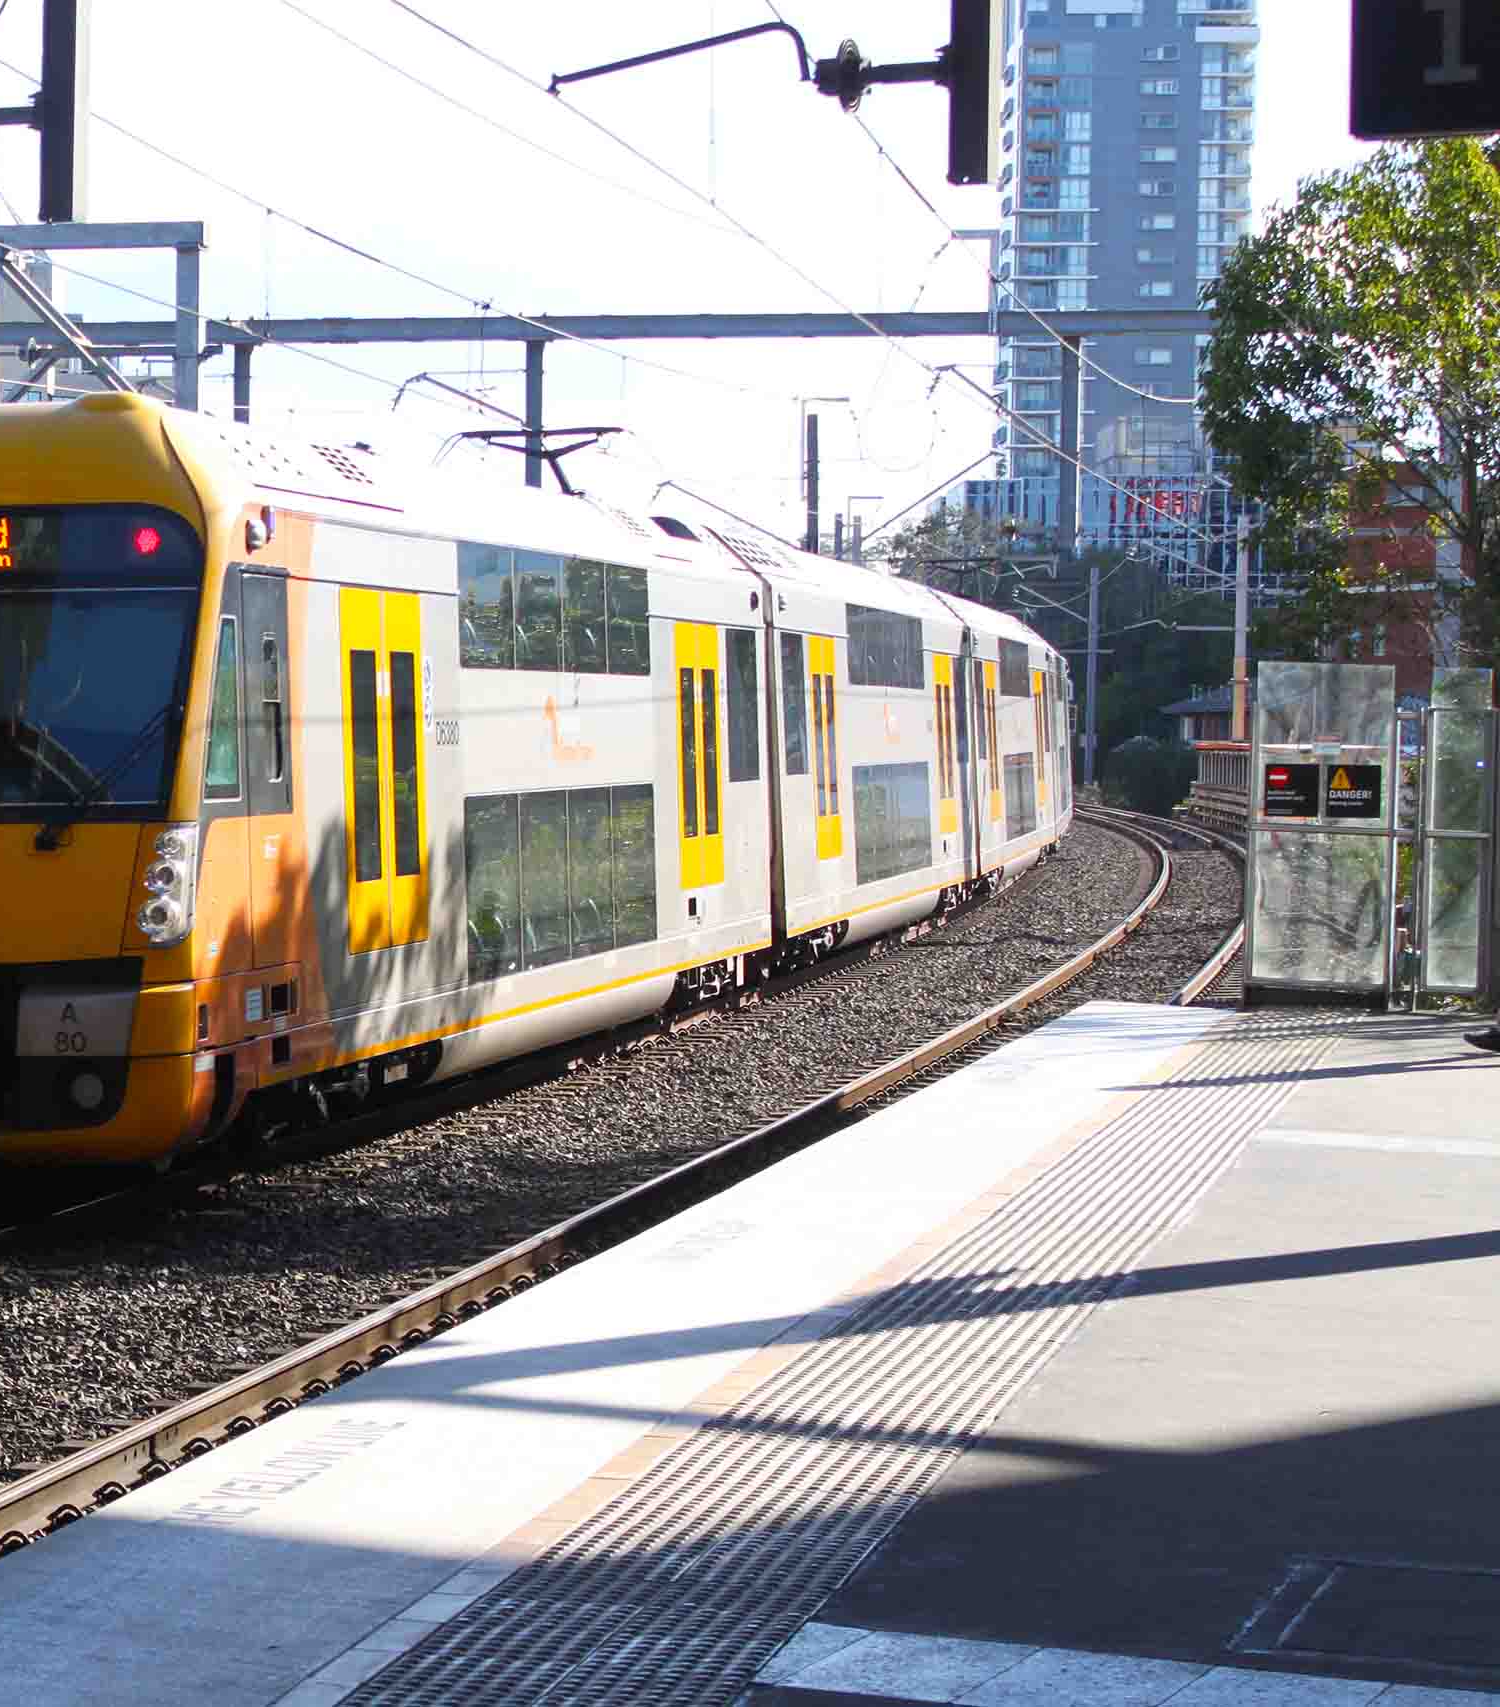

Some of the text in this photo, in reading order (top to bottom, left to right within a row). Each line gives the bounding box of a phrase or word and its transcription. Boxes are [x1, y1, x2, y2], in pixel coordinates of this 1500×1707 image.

[1329, 790, 1373, 799] DANGER!
[60, 1002, 78, 1024] A
[53, 1032, 88, 1053] 80
